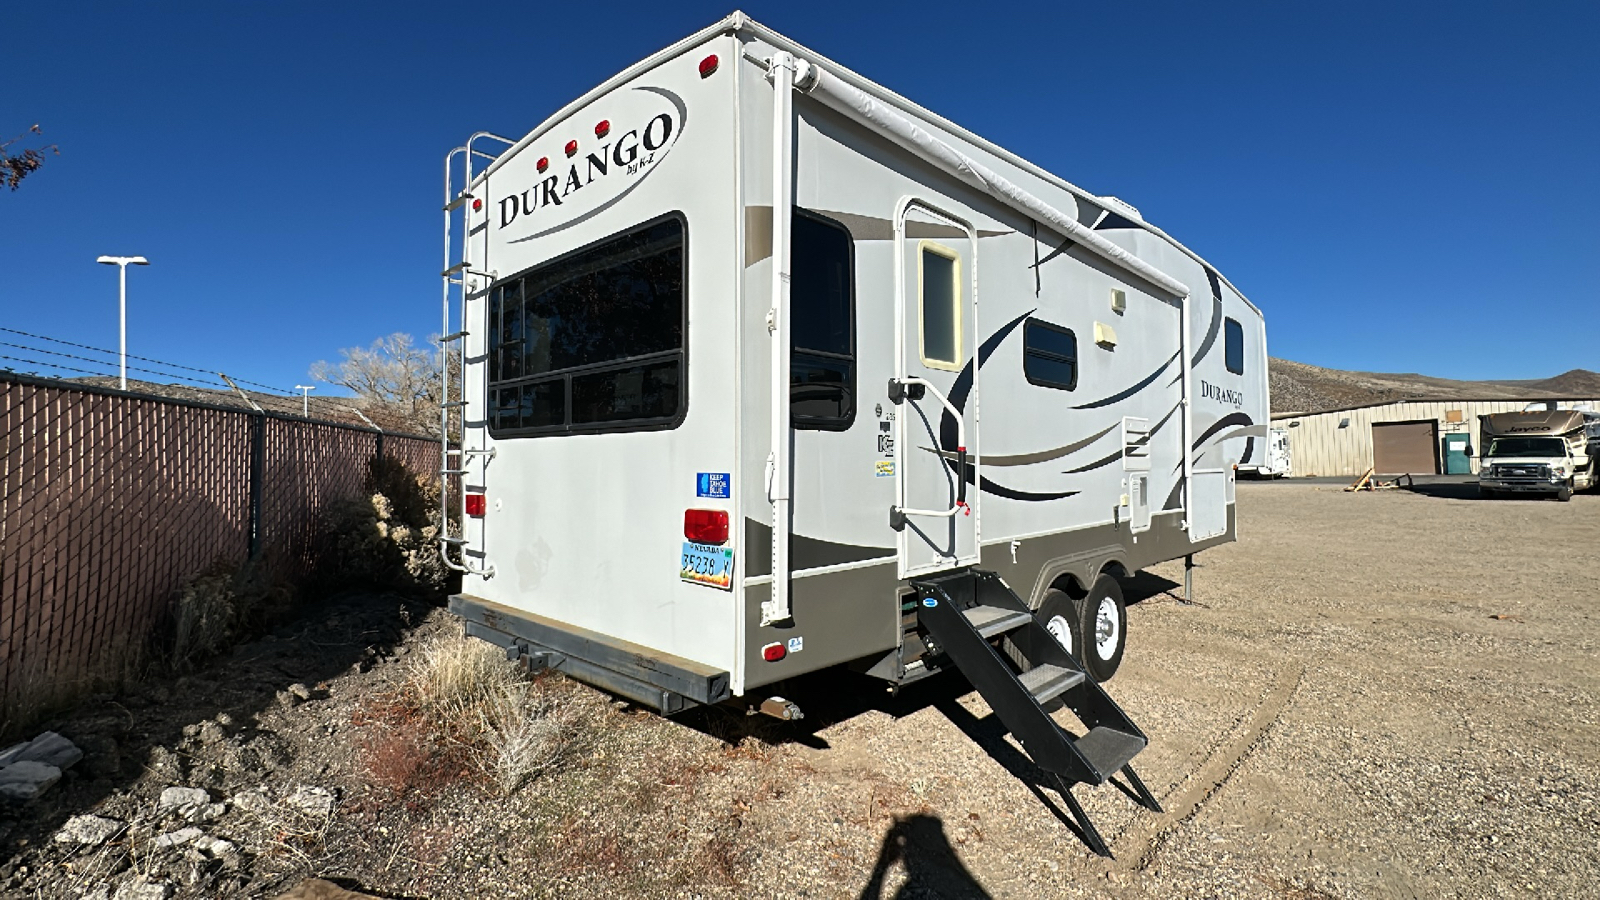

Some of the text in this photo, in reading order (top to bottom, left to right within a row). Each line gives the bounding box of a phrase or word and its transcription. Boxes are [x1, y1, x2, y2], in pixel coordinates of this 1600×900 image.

[498, 113, 673, 230] DURANGO
[626, 151, 656, 175] by K-Z
[1201, 379, 1243, 405] DURANGO
[709, 473, 724, 481] KEEP
[694, 544, 720, 553] NEVADA
[683, 553, 715, 577] 35238
